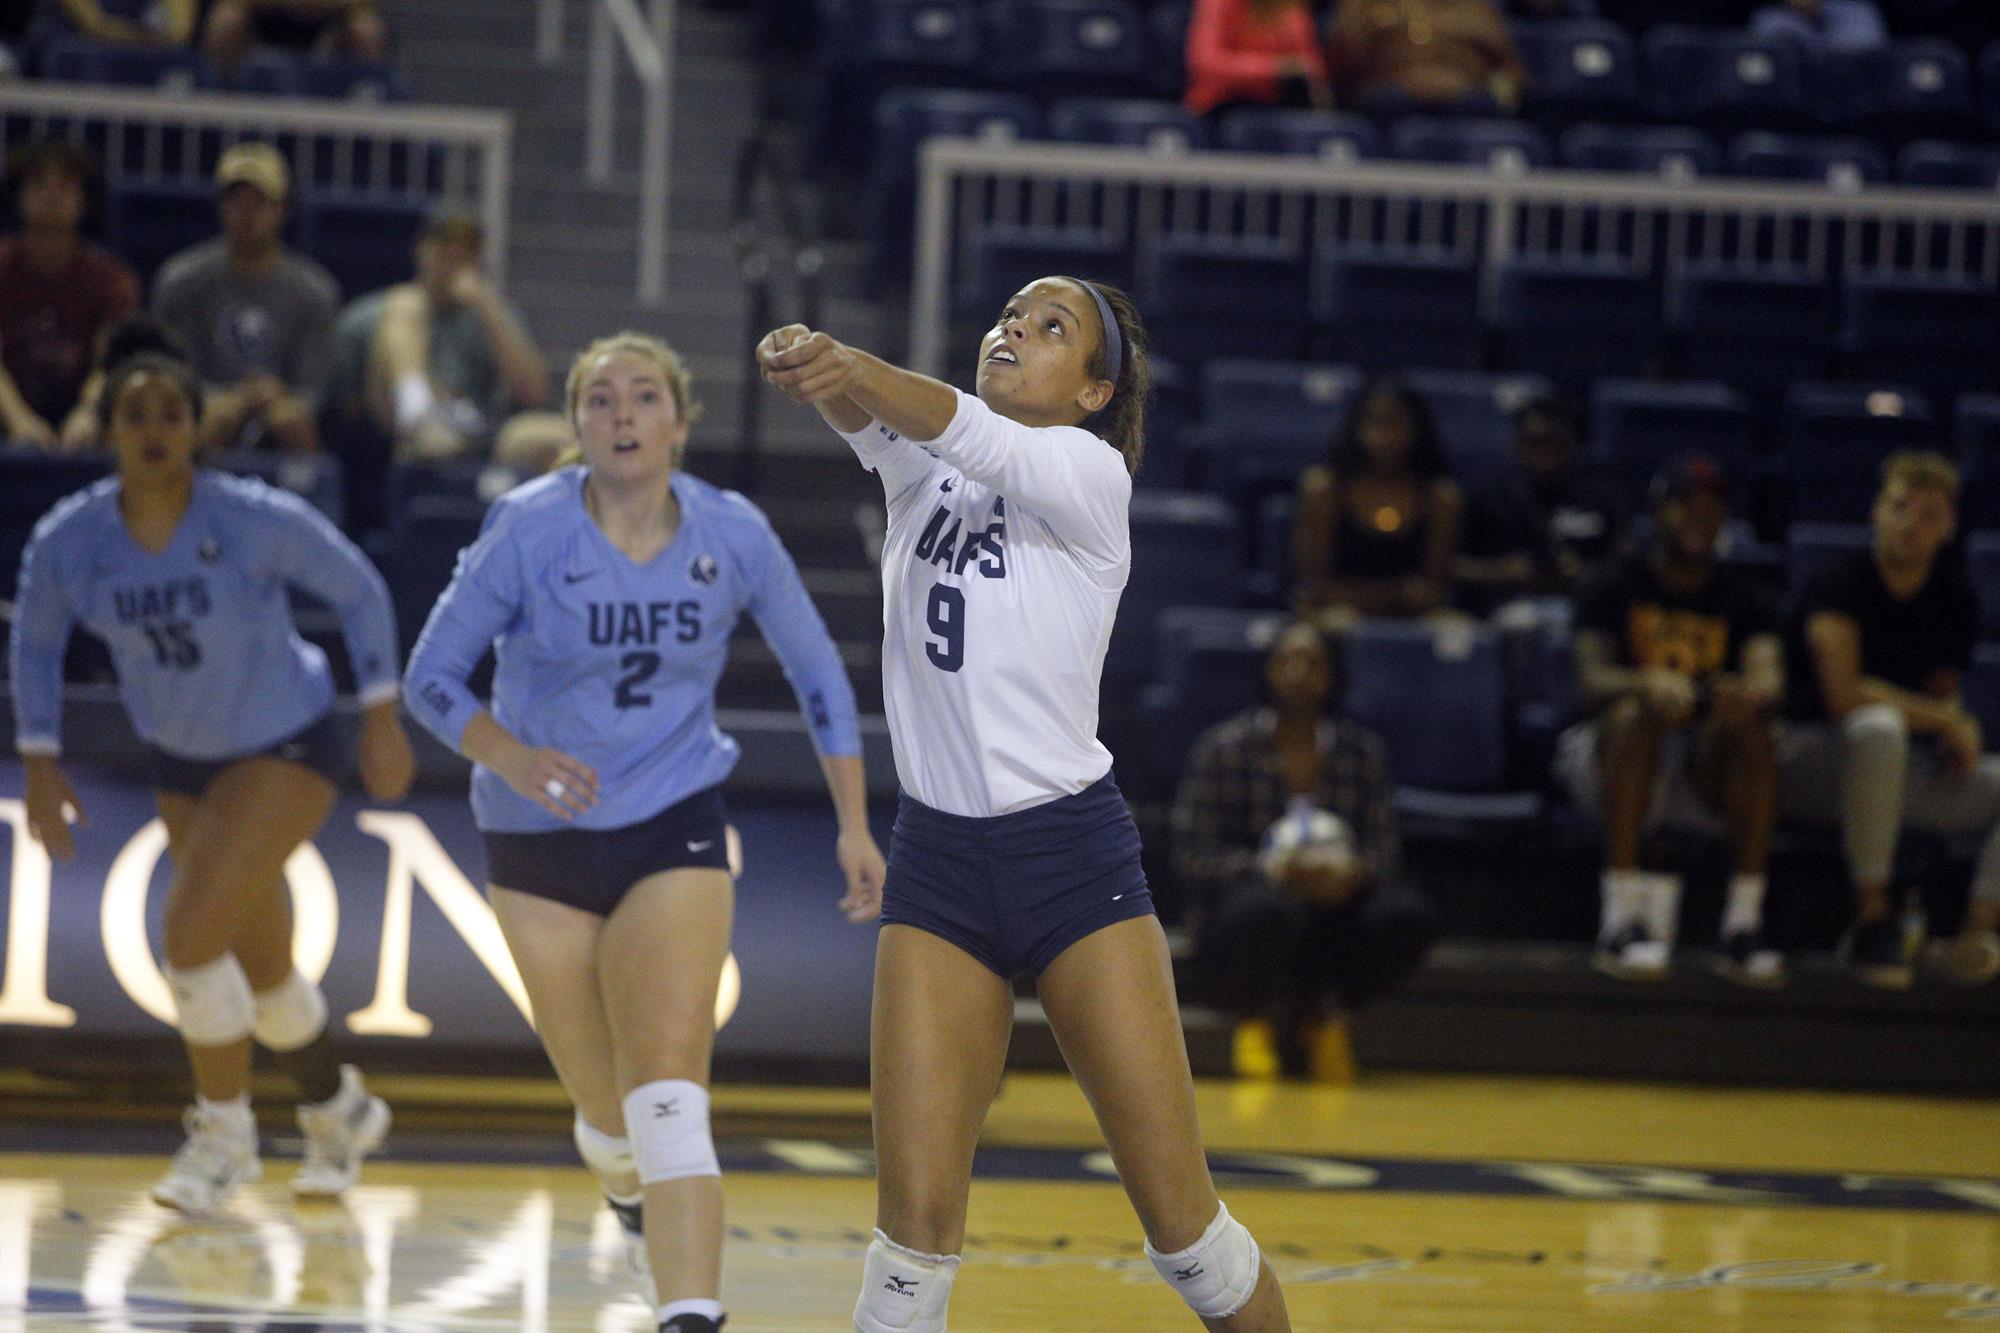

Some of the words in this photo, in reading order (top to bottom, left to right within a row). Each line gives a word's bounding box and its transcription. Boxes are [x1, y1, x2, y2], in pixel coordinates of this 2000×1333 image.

[916, 504, 1006, 579] UAFS
[145, 620, 203, 671] 15
[587, 600, 703, 646] UAFS
[925, 581, 966, 673] 9
[613, 651, 660, 709] 2
